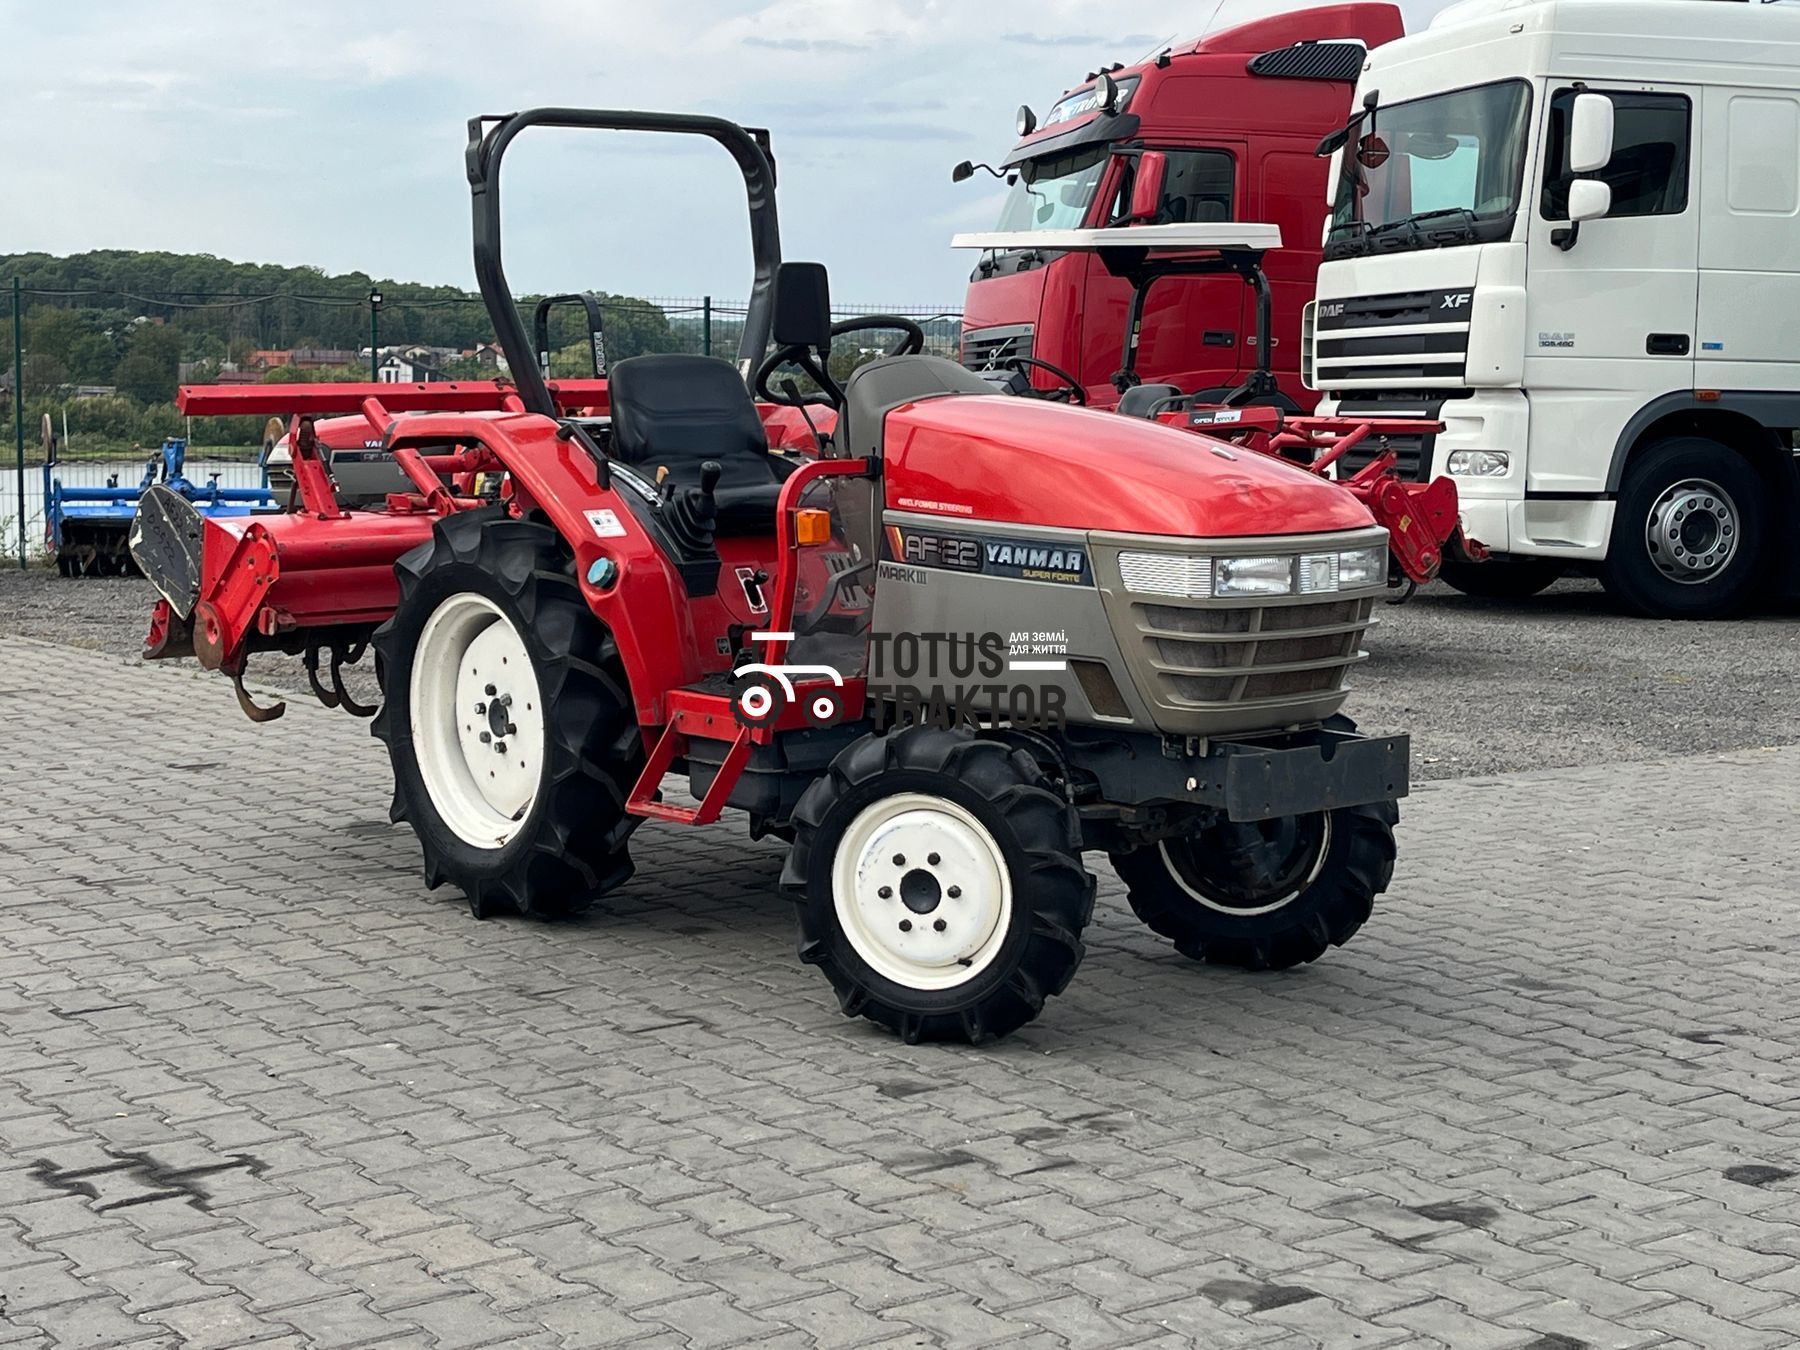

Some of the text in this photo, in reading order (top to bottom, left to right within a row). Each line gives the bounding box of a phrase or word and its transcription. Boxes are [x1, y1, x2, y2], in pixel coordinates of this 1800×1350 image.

[1440, 293, 1471, 309] XF
[1319, 304, 1344, 318] DAF
[986, 543, 1082, 571] YANMAR
[879, 565, 915, 583] MARK
[1022, 568, 1080, 583] SUPER FORTE
